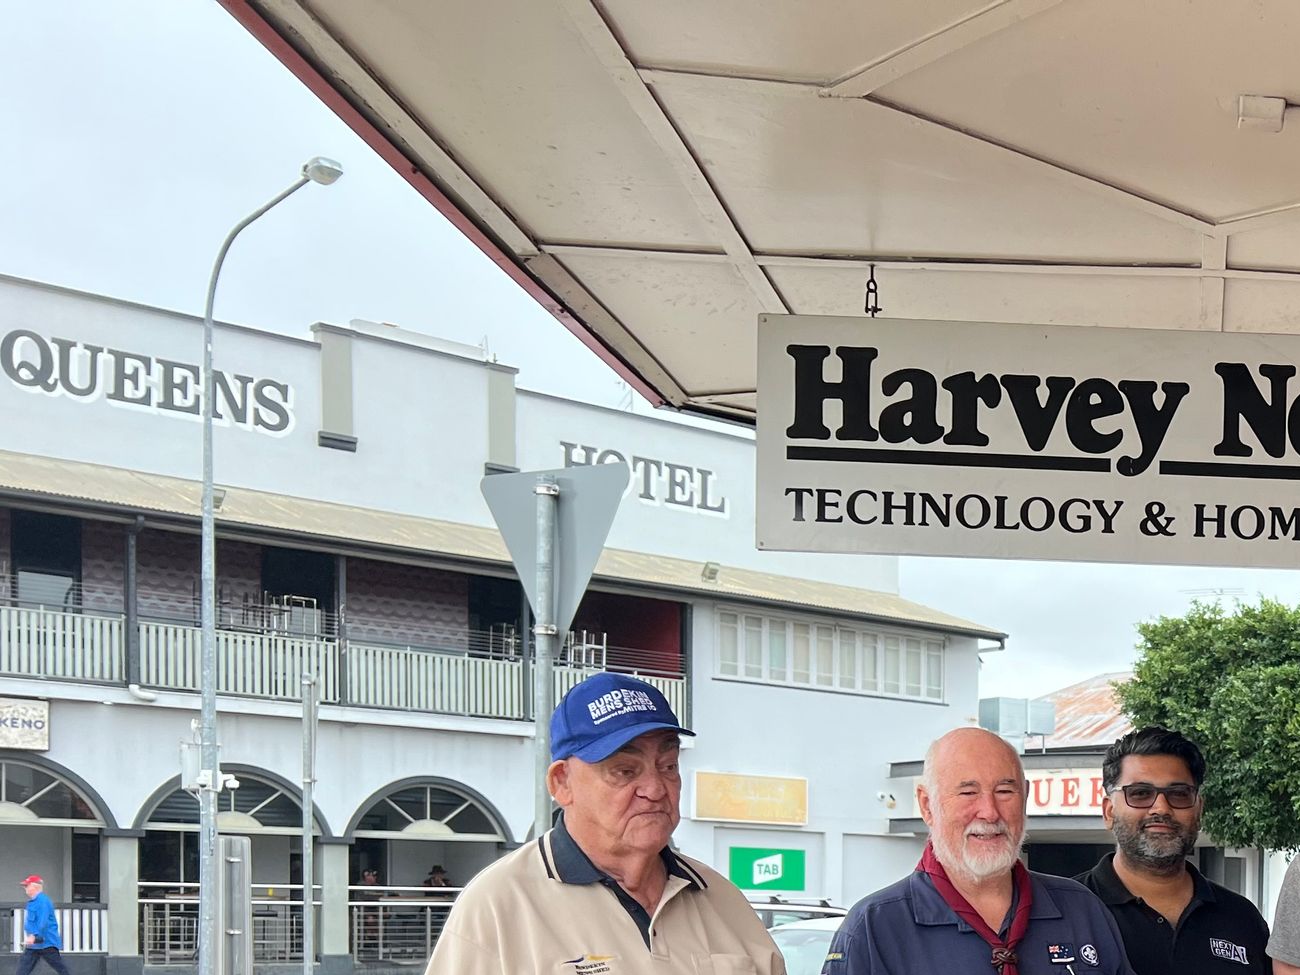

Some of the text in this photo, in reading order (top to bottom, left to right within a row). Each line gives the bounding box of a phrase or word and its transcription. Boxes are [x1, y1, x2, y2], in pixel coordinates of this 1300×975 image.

[0, 329, 290, 432] QUEENS
[786, 344, 1191, 477] Harvey
[784, 487, 1124, 534] TECHNOLOGY
[1139, 501, 1177, 537] &
[587, 688, 651, 712] BURDEKIN
[590, 697, 653, 720] MENS SHED
[0, 717, 45, 730] KENO
[1033, 777, 1105, 807] UEE
[757, 863, 780, 876] TAB
[1212, 939, 1232, 951] NEXT
[1215, 948, 1231, 958] GEN
